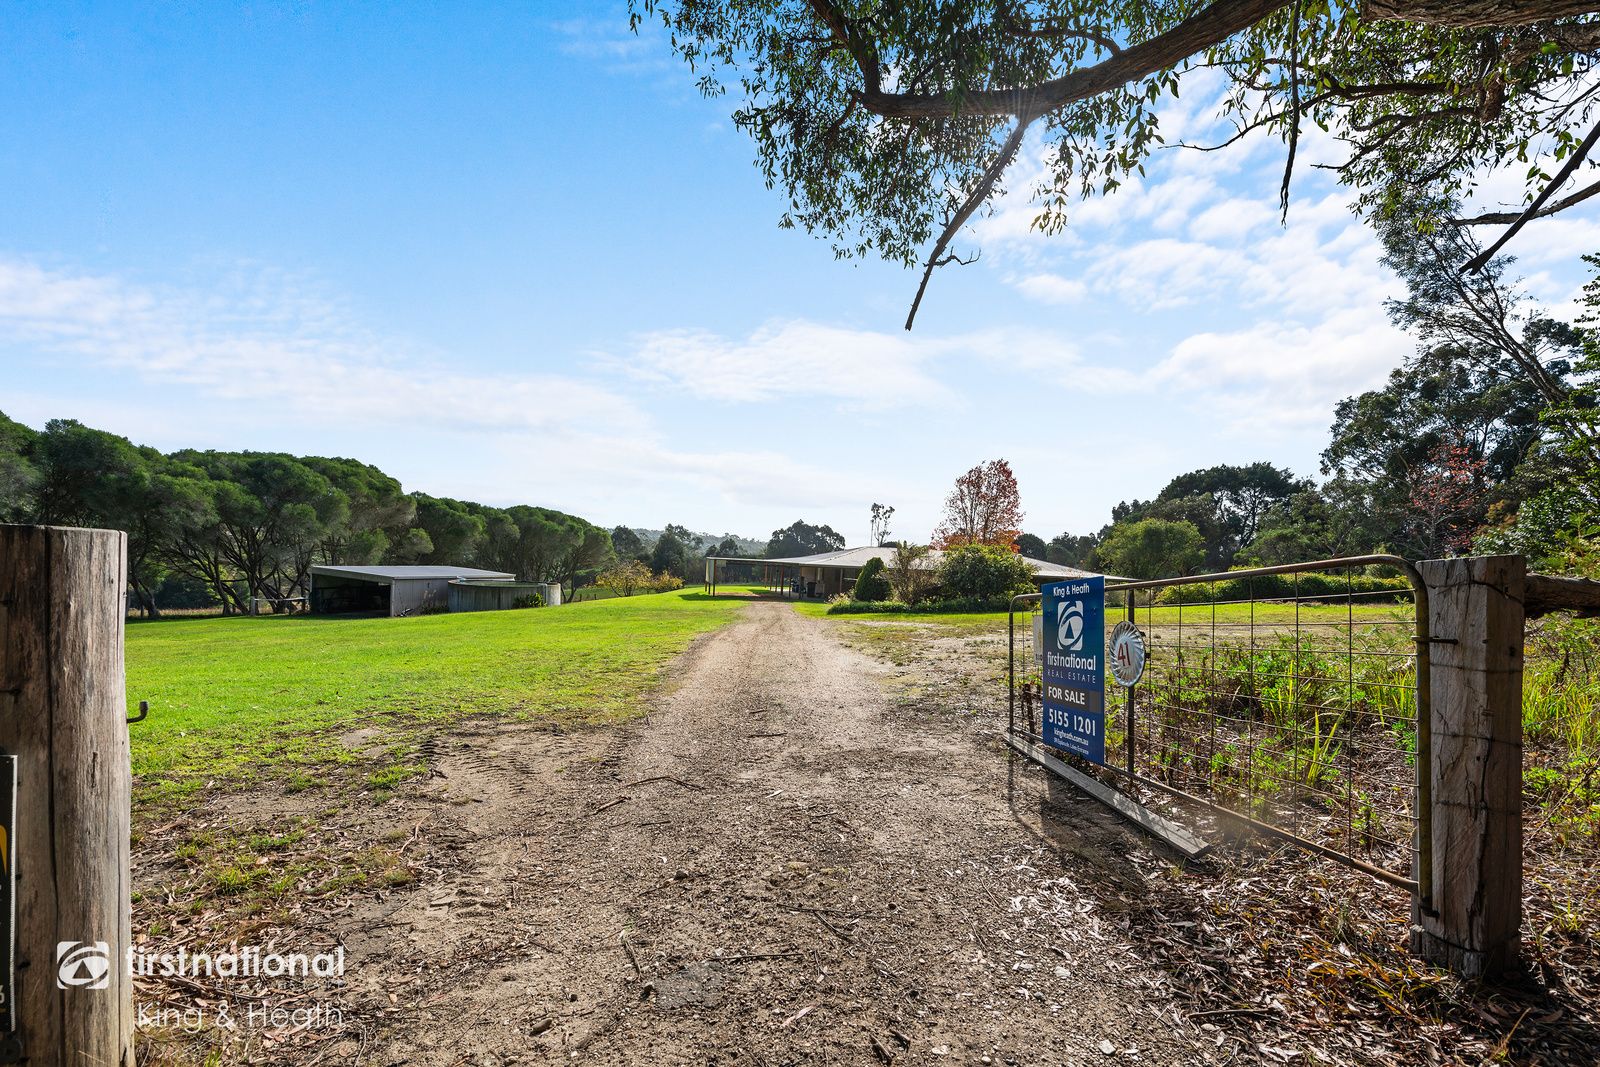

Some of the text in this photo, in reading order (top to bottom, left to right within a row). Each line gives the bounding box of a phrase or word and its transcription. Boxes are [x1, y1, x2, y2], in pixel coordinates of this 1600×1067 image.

[1053, 584, 1090, 598] King & Heath
[1047, 651, 1097, 671] firstnational
[1117, 641, 1131, 667] 41
[1047, 668, 1096, 684] REAL ESTATE
[1048, 685, 1086, 705] FOR SALE
[1048, 708, 1096, 737] 5155 1201
